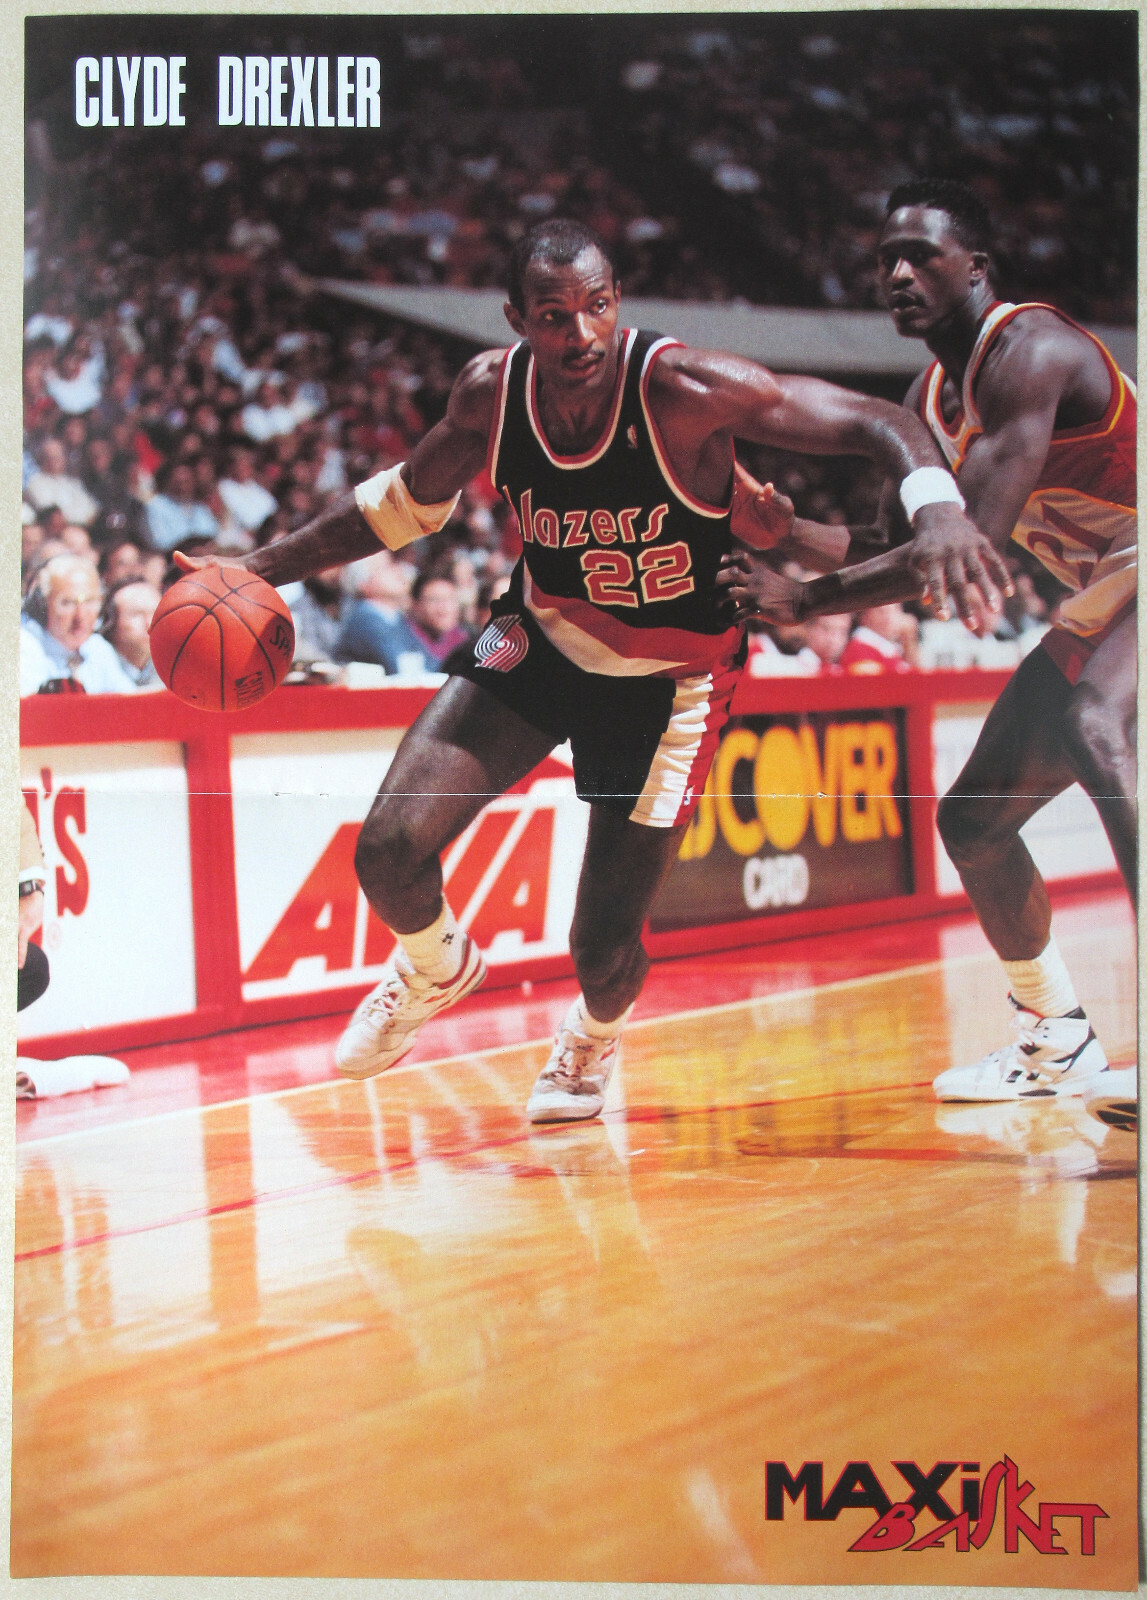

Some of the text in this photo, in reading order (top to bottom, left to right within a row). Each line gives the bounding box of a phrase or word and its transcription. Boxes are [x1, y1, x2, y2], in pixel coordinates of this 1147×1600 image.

[75, 55, 381, 128] CLYDE DREXLER
[580, 540, 695, 609] 22
[847, 1453, 1110, 1555] BASKET
